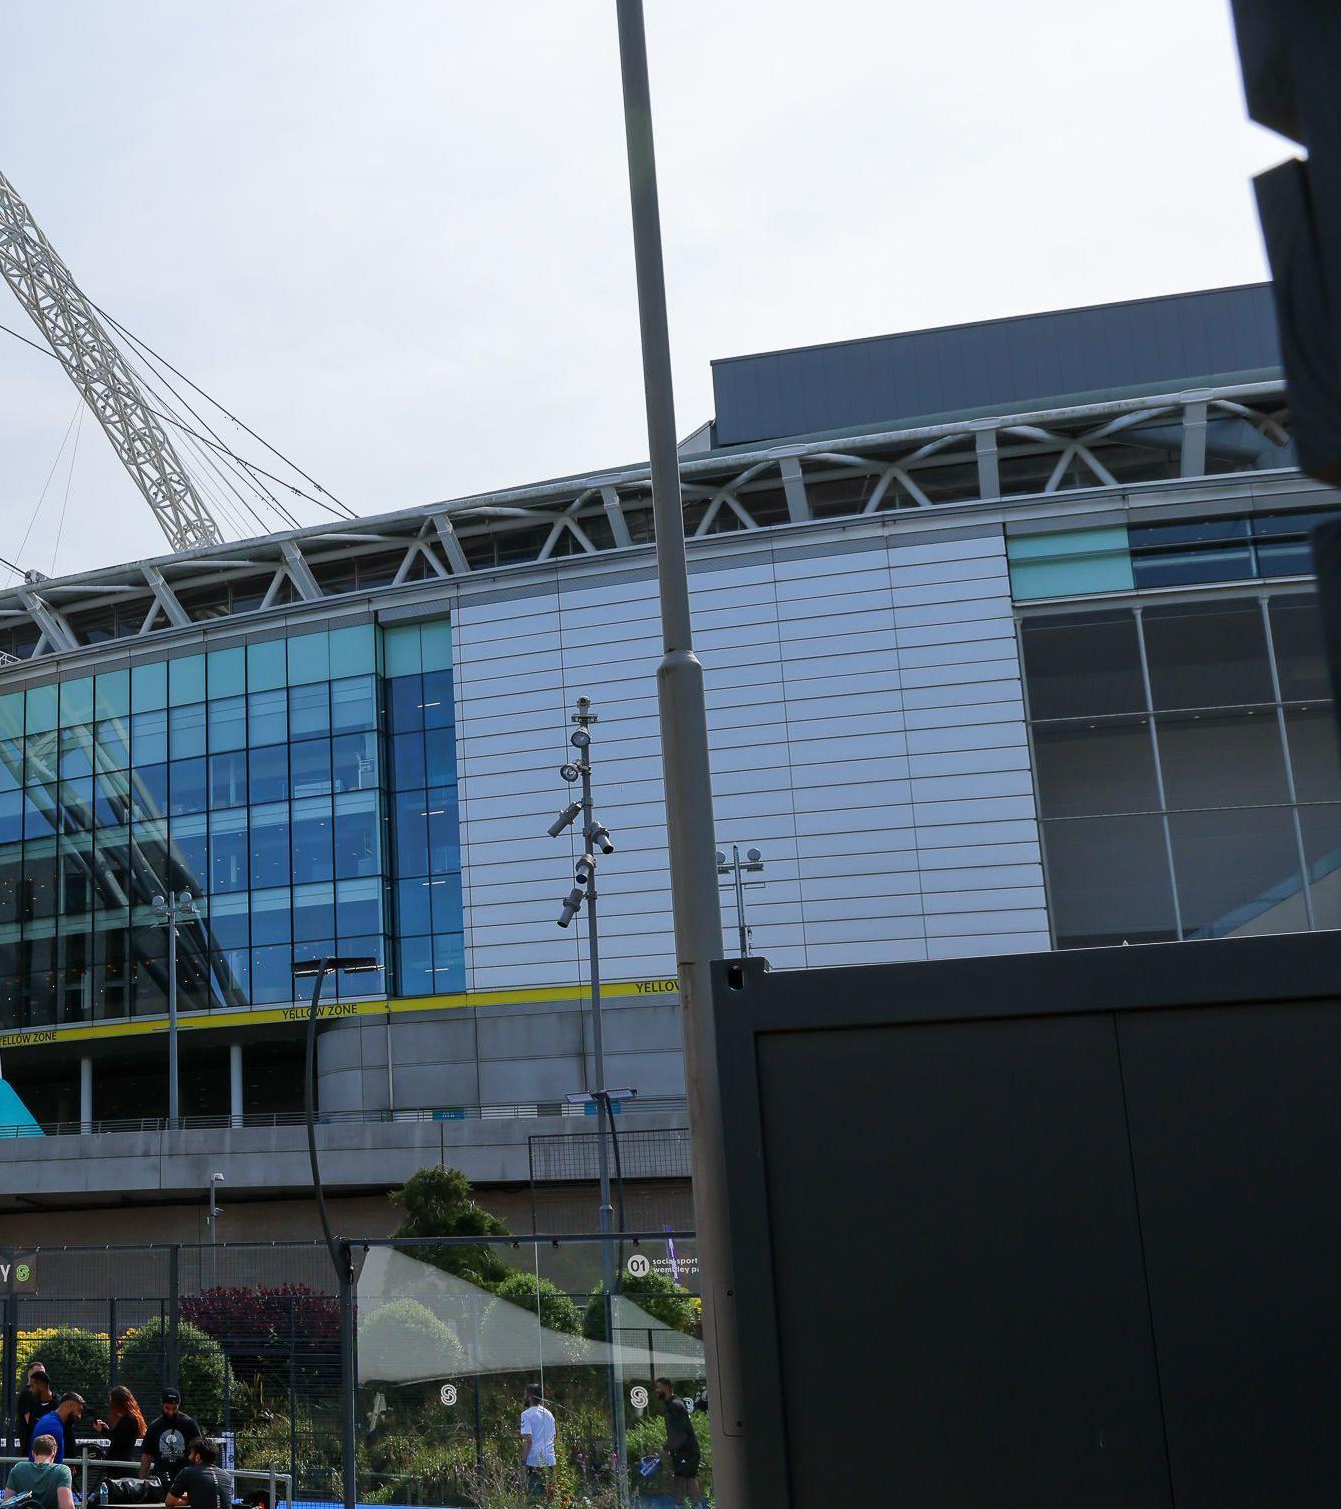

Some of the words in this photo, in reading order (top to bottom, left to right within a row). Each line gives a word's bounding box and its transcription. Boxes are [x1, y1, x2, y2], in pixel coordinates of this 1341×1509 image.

[328, 1004, 357, 1015] ZONE
[33, 1032, 57, 1042] ZONE
[631, 1260, 646, 1272] 01
